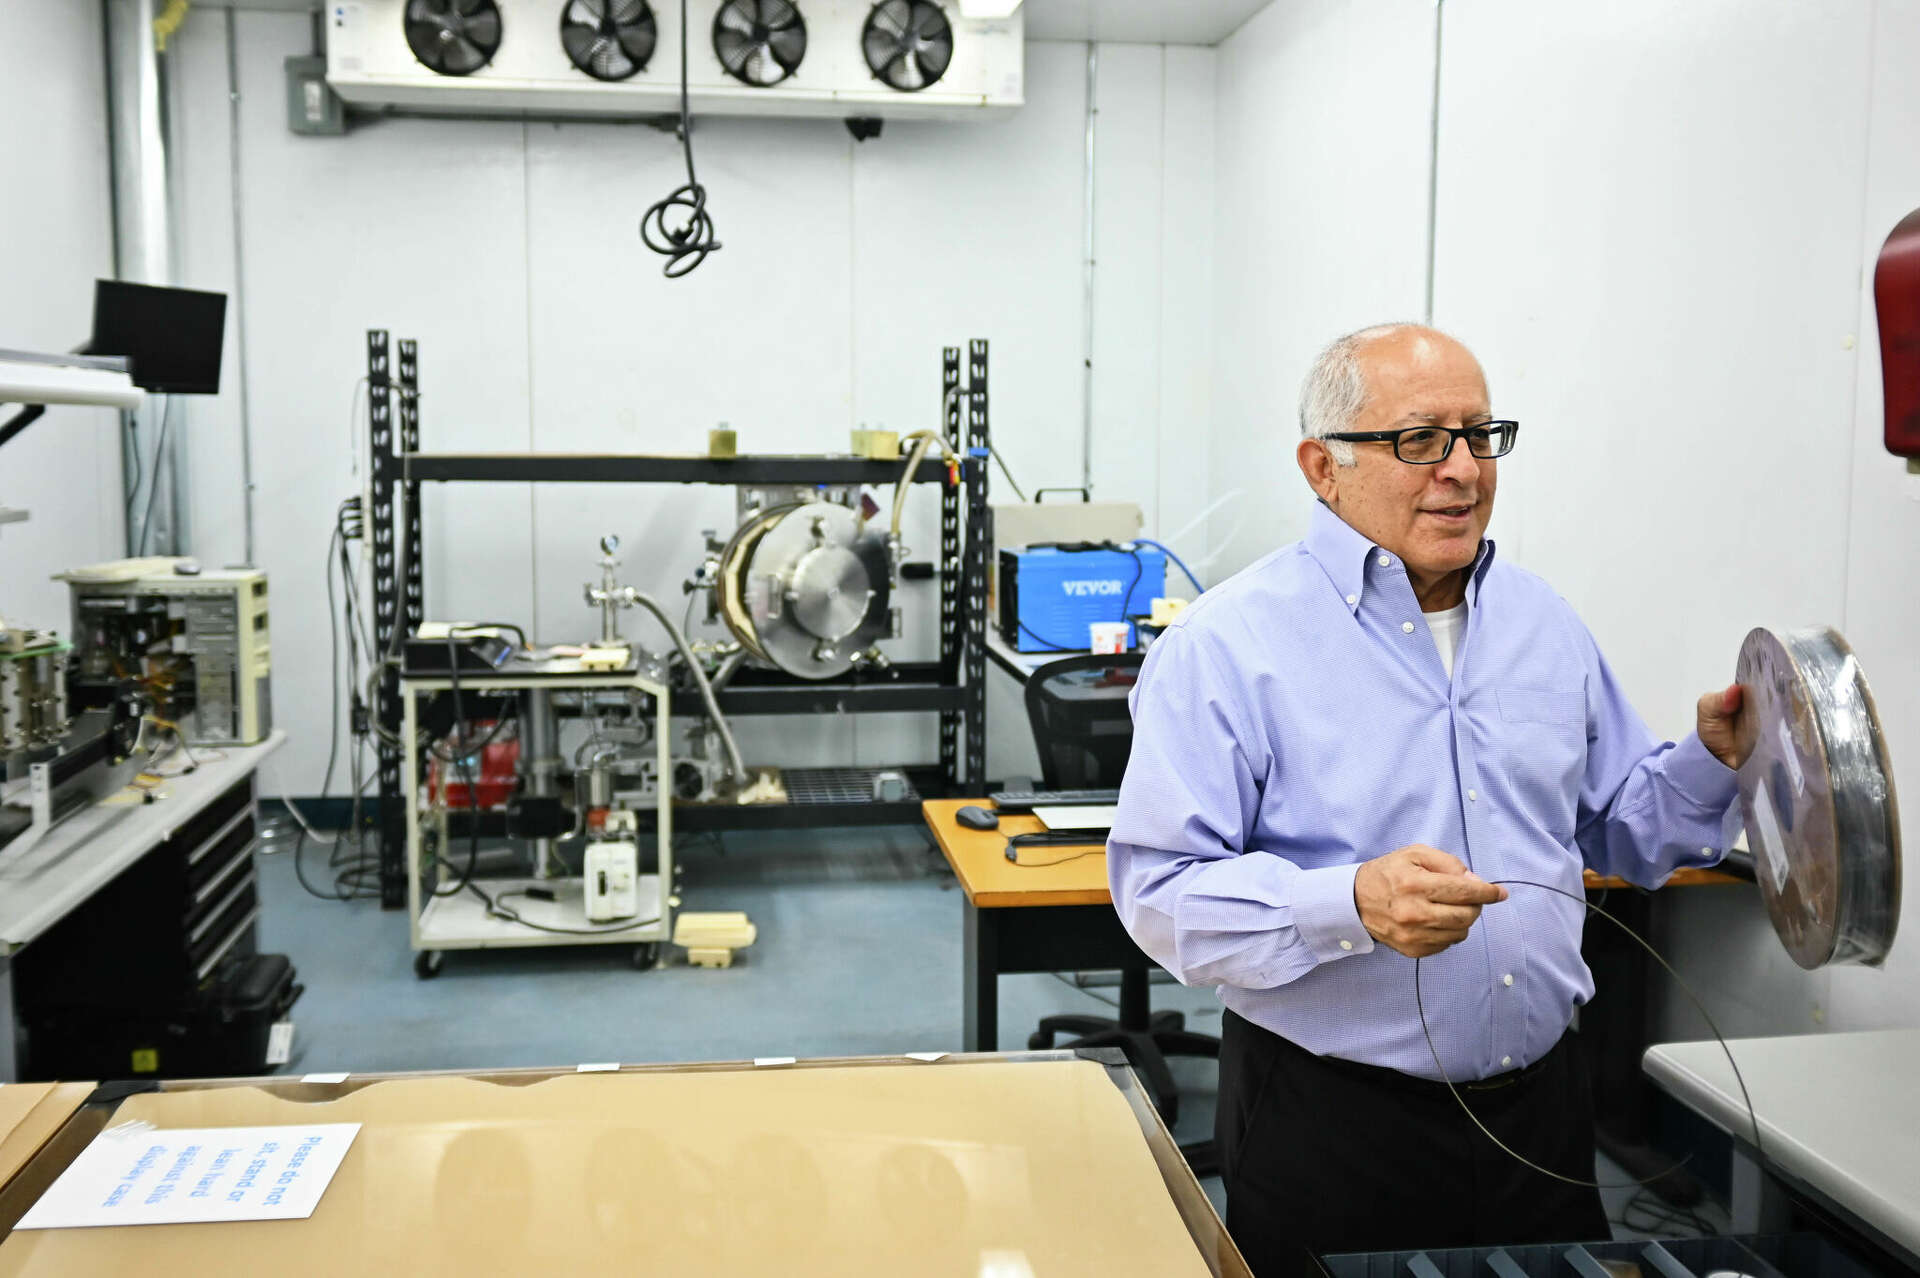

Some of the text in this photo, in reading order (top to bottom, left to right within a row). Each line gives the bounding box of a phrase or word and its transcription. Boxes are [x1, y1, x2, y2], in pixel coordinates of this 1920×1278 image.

[1062, 580, 1122, 596] VEVOR
[101, 1145, 168, 1207] display case
[144, 1145, 202, 1204] against this
[188, 1148, 243, 1197] lean hard
[234, 1159, 267, 1188] stand
[261, 1136, 323, 1205] Please do not
[224, 1190, 246, 1202] or
